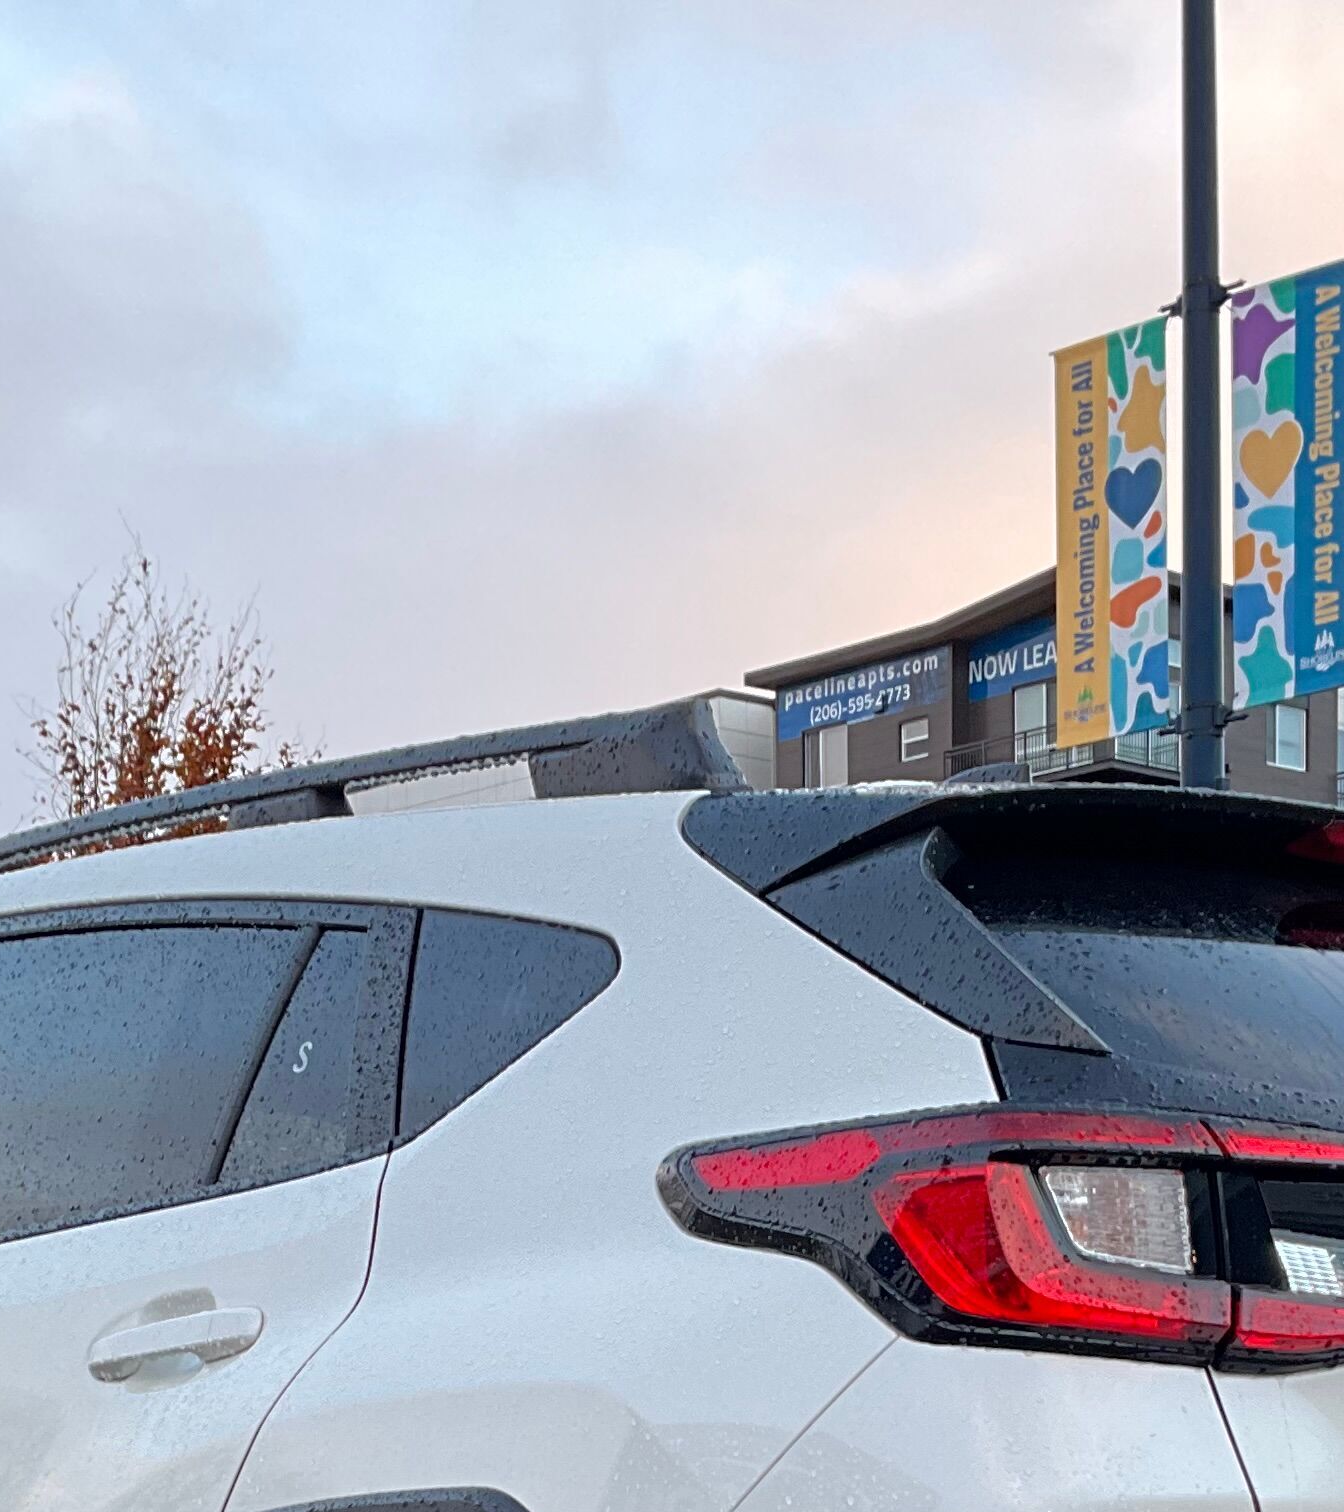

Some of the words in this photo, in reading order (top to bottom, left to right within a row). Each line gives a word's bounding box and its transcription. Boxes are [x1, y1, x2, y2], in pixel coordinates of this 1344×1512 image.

[1314, 283, 1341, 305] A
[1071, 359, 1093, 393] All
[1309, 306, 1341, 461] Welcoming
[1073, 400, 1093, 438] for
[1073, 440, 1094, 512] Place
[1314, 461, 1341, 539] Place
[1314, 543, 1340, 584] for
[1073, 514, 1100, 656] Welcoming
[1314, 590, 1340, 626] All
[784, 654, 939, 711] pacelineapts.com
[968, 650, 1018, 685] NOW
[1074, 656, 1095, 674] A
[292, 1040, 313, 1074] S
